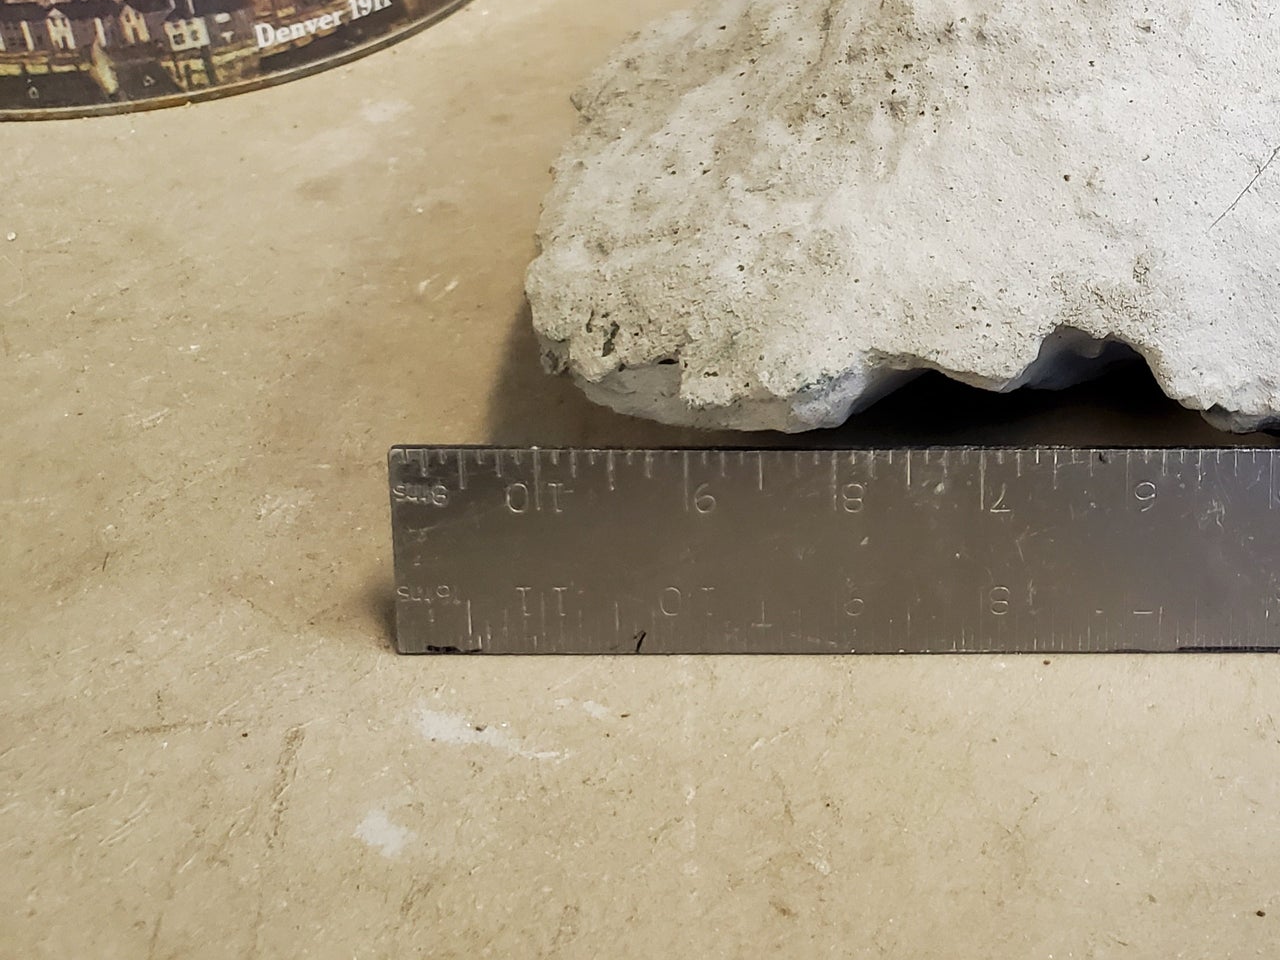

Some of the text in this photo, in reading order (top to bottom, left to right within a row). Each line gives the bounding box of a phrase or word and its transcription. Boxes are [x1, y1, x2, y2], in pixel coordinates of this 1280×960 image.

[253, 9, 346, 48] Denver
[841, 482, 865, 513] 8
[989, 585, 1012, 616] 8
